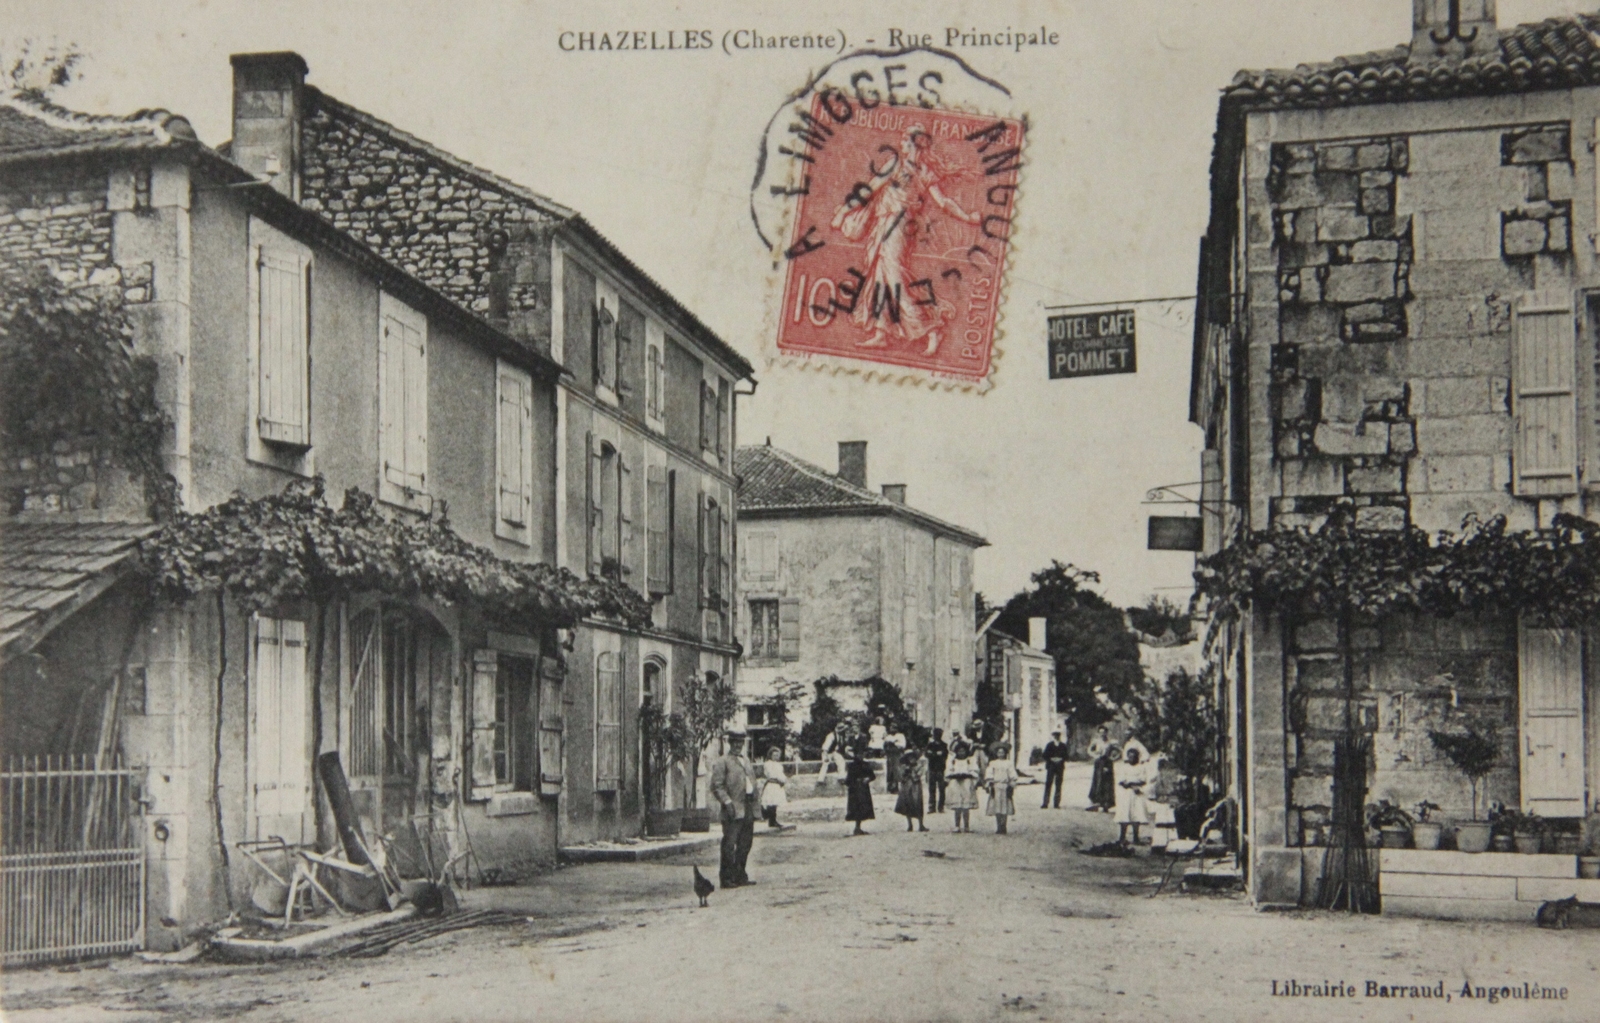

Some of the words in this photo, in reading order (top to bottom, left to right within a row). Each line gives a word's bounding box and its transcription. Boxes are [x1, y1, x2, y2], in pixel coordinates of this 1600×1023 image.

[769, 64, 944, 198] LIMOGES
[818, 101, 906, 132] RUBLIQUE
[931, 118, 1013, 147] FRANSE
[961, 276, 991, 359] POSTES
[1055, 348, 1129, 374] POMMET
